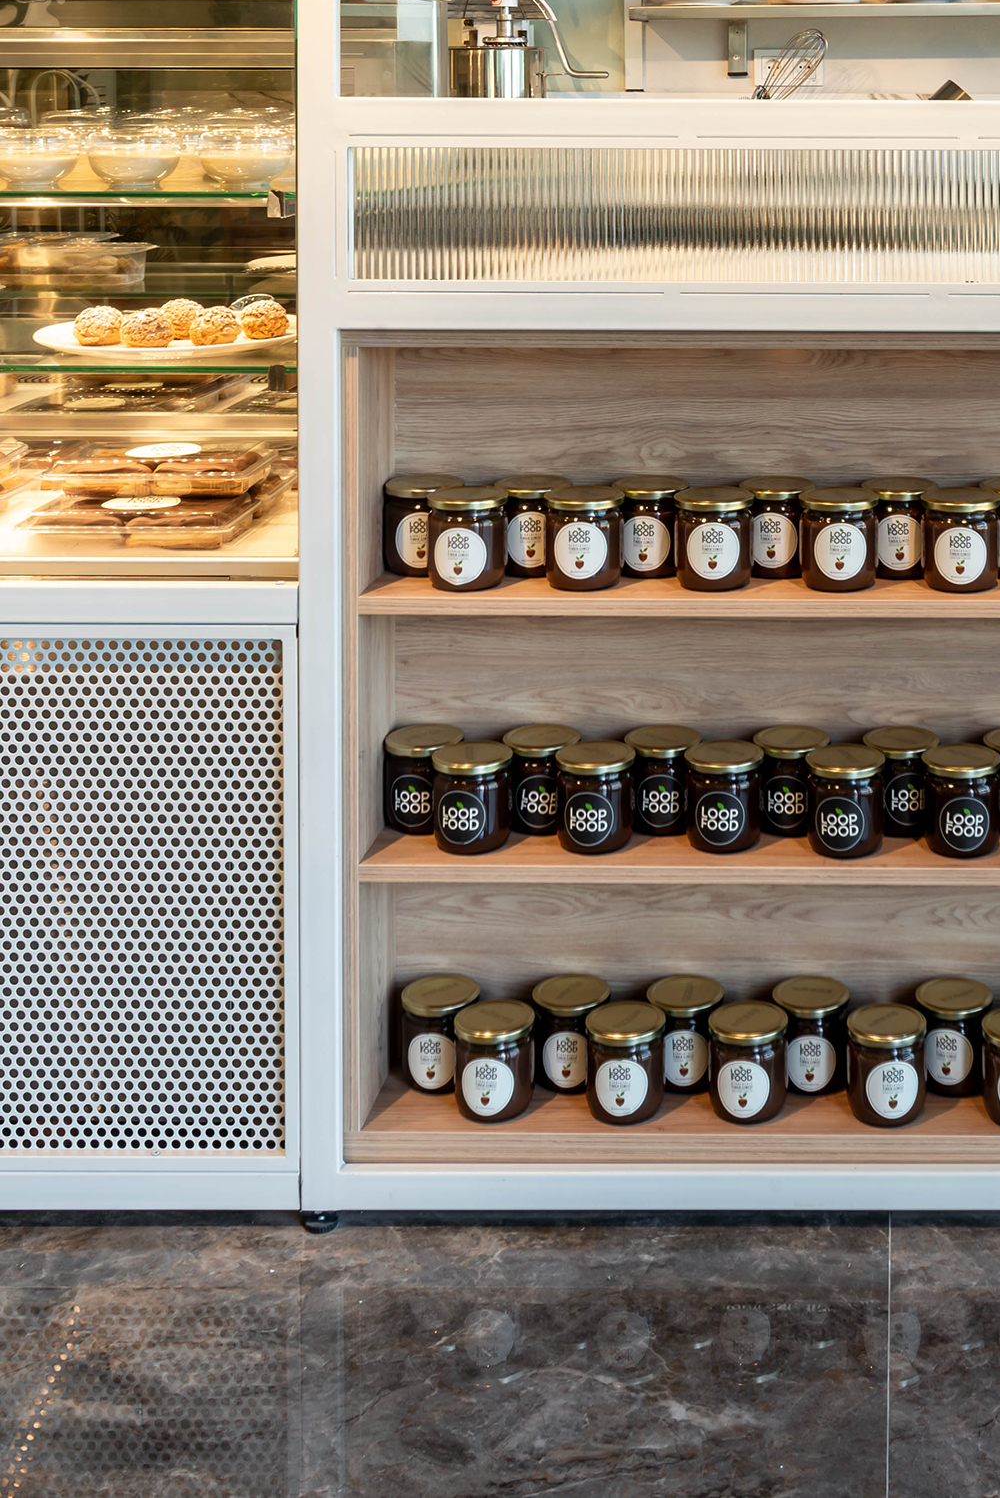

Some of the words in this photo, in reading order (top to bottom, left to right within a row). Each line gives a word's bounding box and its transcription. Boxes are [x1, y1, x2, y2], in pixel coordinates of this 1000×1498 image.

[395, 789, 430, 803] LOOP
[643, 789, 679, 803] LOOP
[768, 790, 804, 804] LOOP
[395, 800, 430, 814] FOOD
[442, 805, 479, 819] LOOP
[643, 801, 679, 814] FOOD
[701, 806, 738, 820] LOOP
[768, 802, 804, 815] FOOD
[570, 807, 607, 821] LOOP
[821, 812, 858, 826] LOOP
[946, 811, 984, 826] LOOP
[442, 818, 479, 831] FOOD
[570, 820, 608, 832] FOOD
[701, 818, 739, 831] FOOD
[821, 824, 859, 837] FOOD
[946, 824, 984, 837] FOOD
[672, 1038, 693, 1046] LOOP
[672, 1044, 694, 1052] FOOD
[800, 1043, 821, 1051] LOOP
[936, 1043, 957, 1051] FOOD
[475, 1066, 497, 1074] LOOP
[730, 1068, 752, 1076] LOOP
[882, 1069, 904, 1077] LOOP
[730, 1074, 752, 1082] FOOD
[882, 1075, 904, 1083] FOOD
